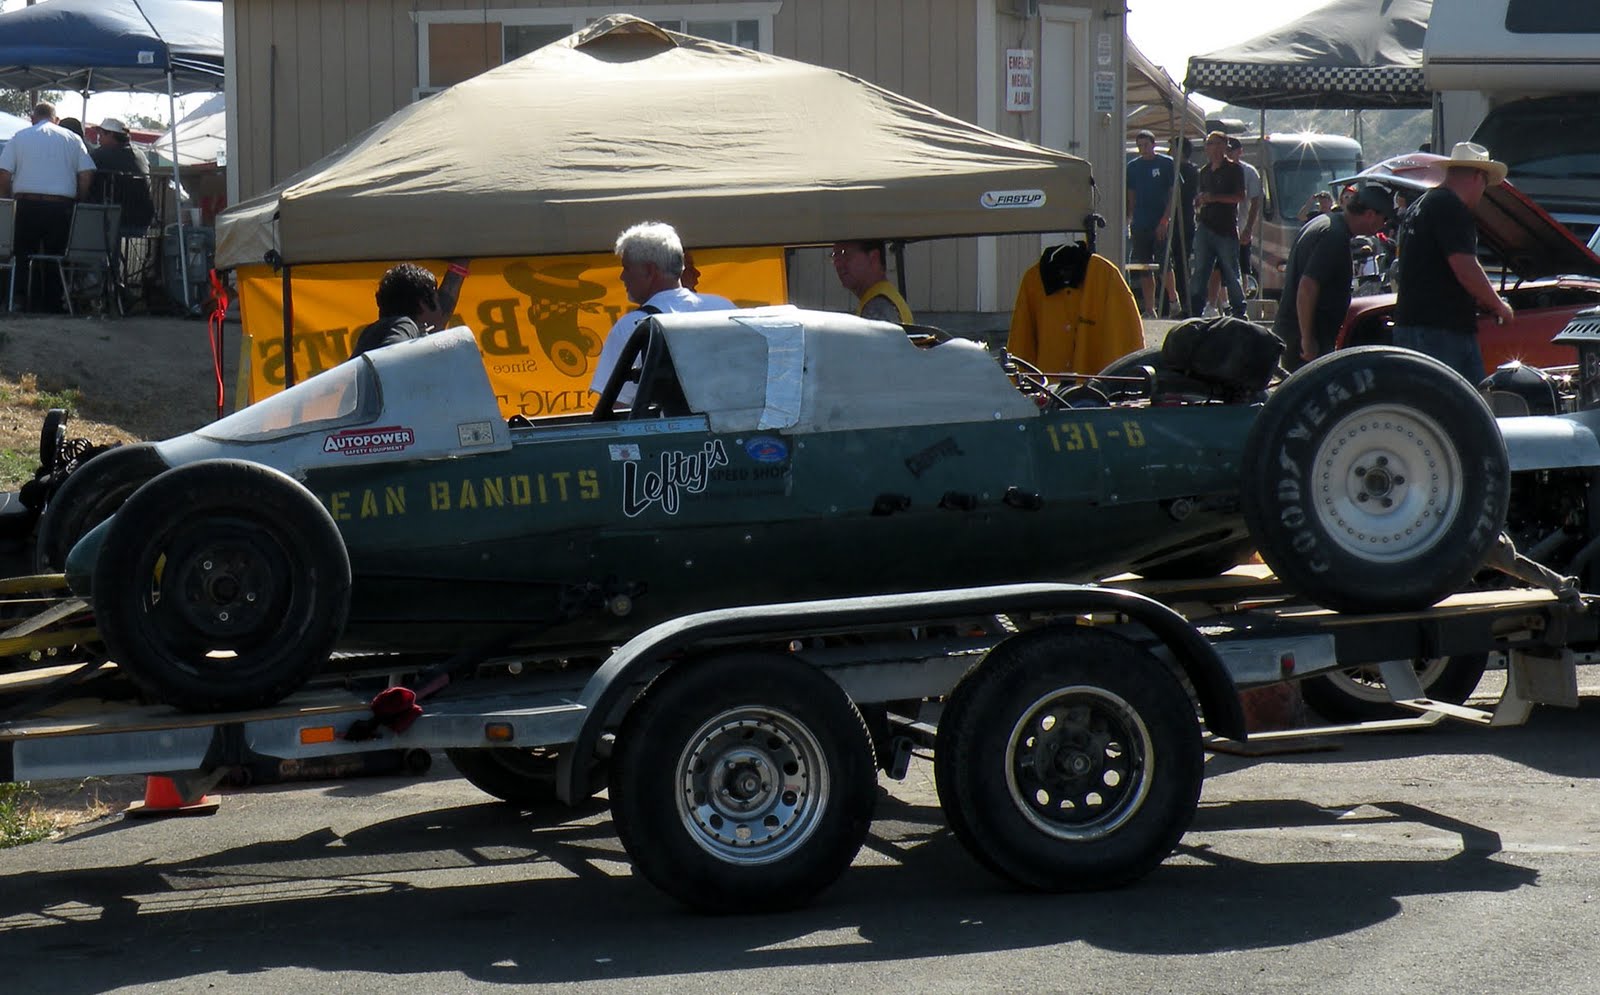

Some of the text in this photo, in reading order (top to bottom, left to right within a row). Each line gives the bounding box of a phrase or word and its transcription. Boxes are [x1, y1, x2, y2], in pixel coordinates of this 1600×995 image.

[1014, 92, 1030, 105] ALARM
[324, 432, 410, 452] AUTOPOWER
[369, 445, 403, 453] EQUIPMENT
[623, 439, 729, 517] Lefty's
[752, 465, 788, 480] SHOP
[330, 469, 600, 521] EAN BANDITS
